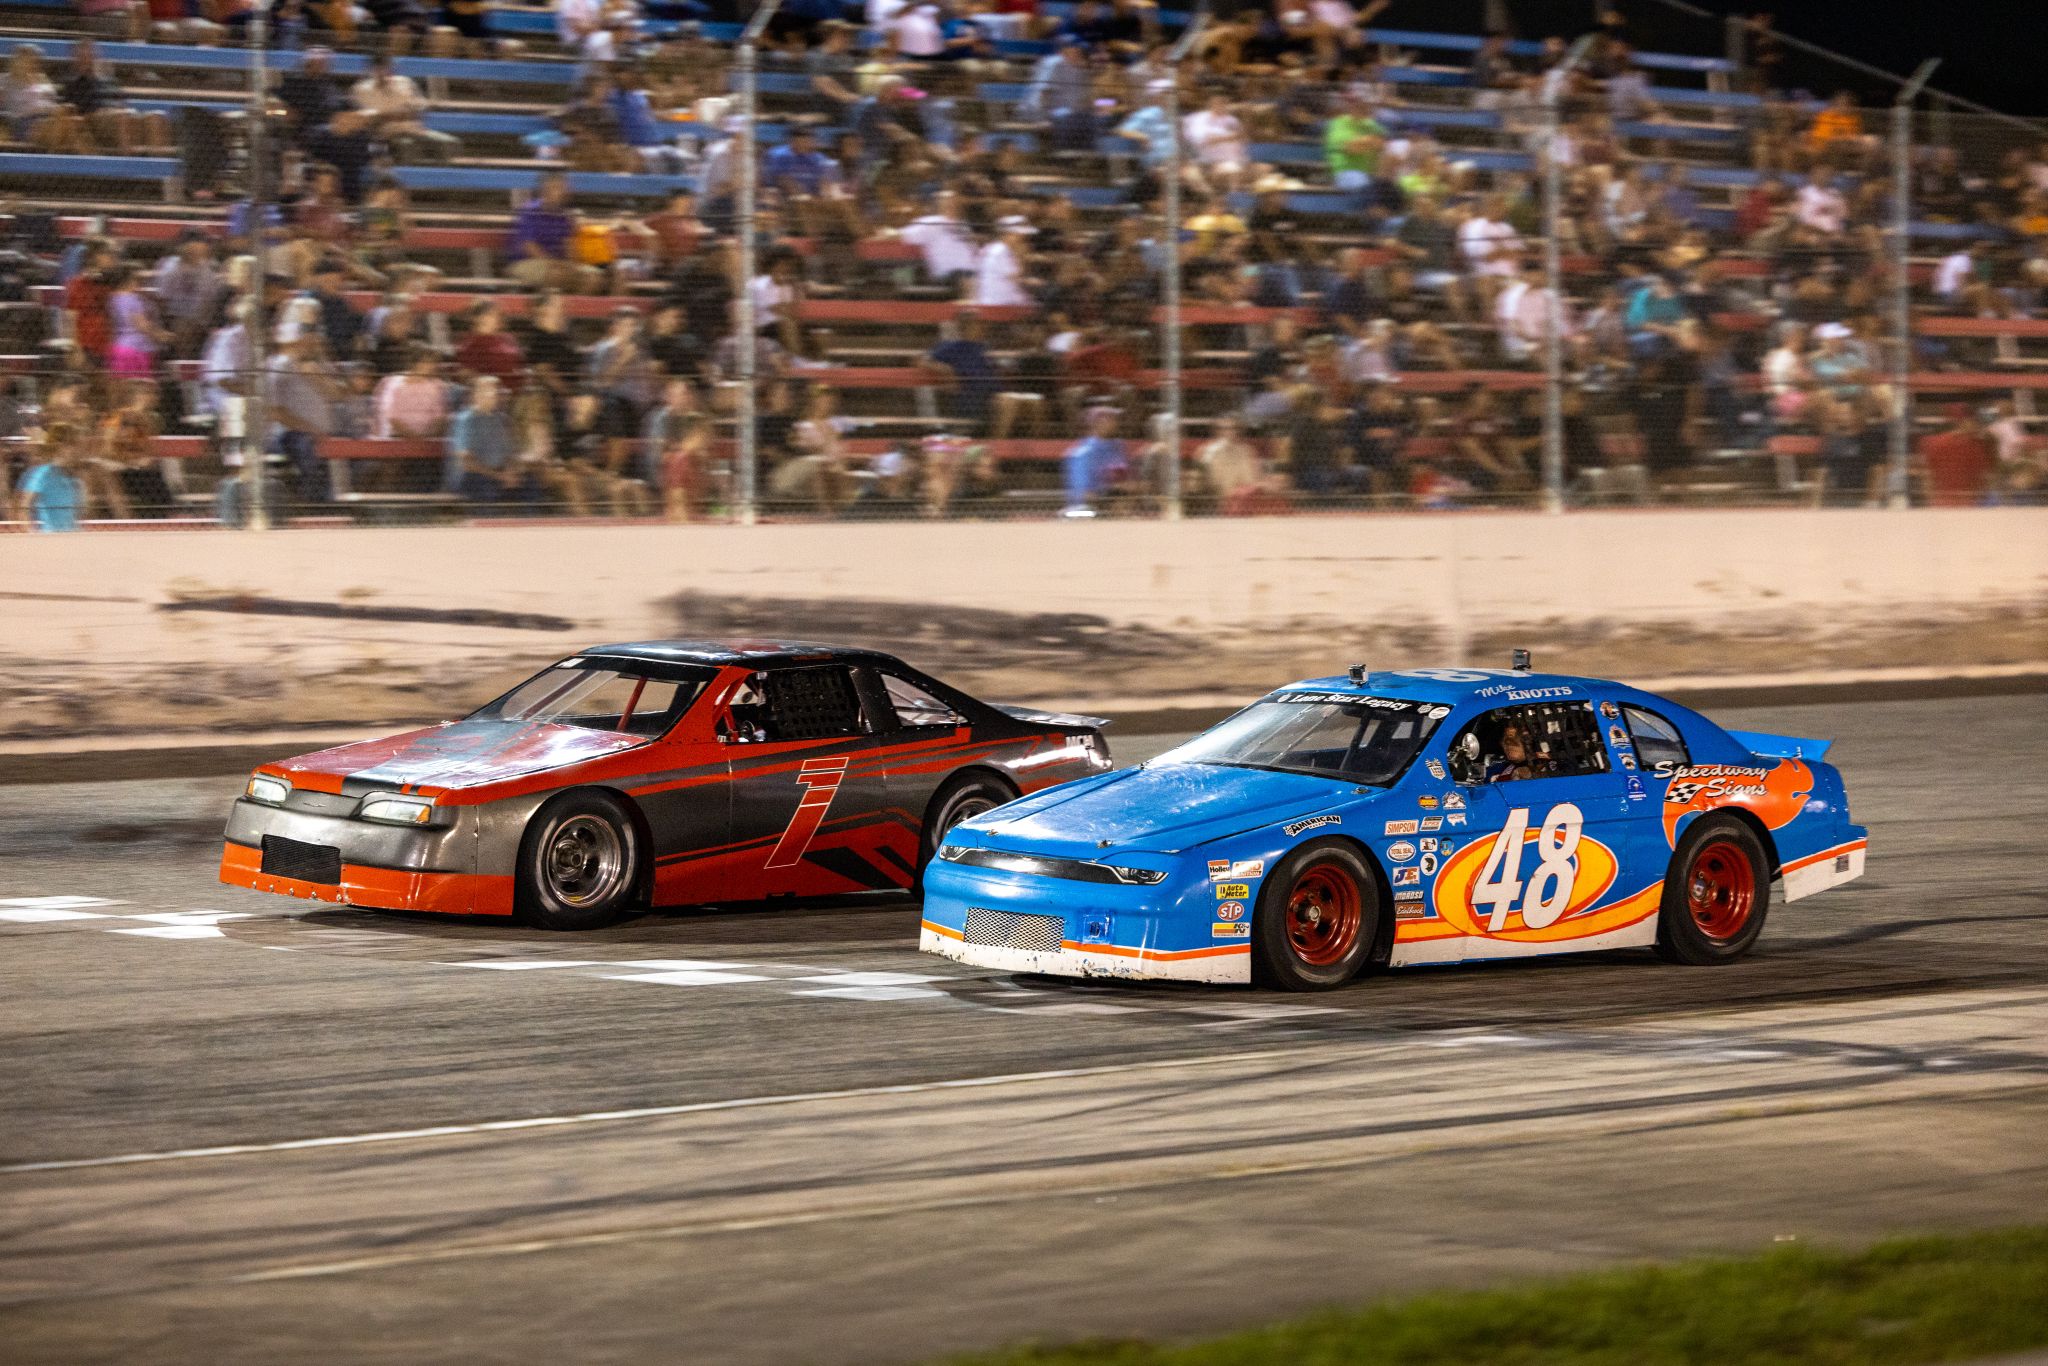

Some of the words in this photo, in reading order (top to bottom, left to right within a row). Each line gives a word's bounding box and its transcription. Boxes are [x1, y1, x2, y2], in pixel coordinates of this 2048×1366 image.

[1474, 684, 1516, 698] Mike
[1508, 686, 1572, 700] KNOTTS
[1356, 696, 1412, 711] Legacy
[1654, 760, 1770, 781] Speedway
[1705, 777, 1768, 797] Signs
[1291, 816, 1340, 834] AMERICAN
[1387, 822, 1416, 833] SIMPSON
[1471, 803, 1584, 932] 48
[1394, 891, 1424, 900] MOROSO
[1220, 903, 1242, 918] STP
[1396, 905, 1424, 915] Edelbrock
